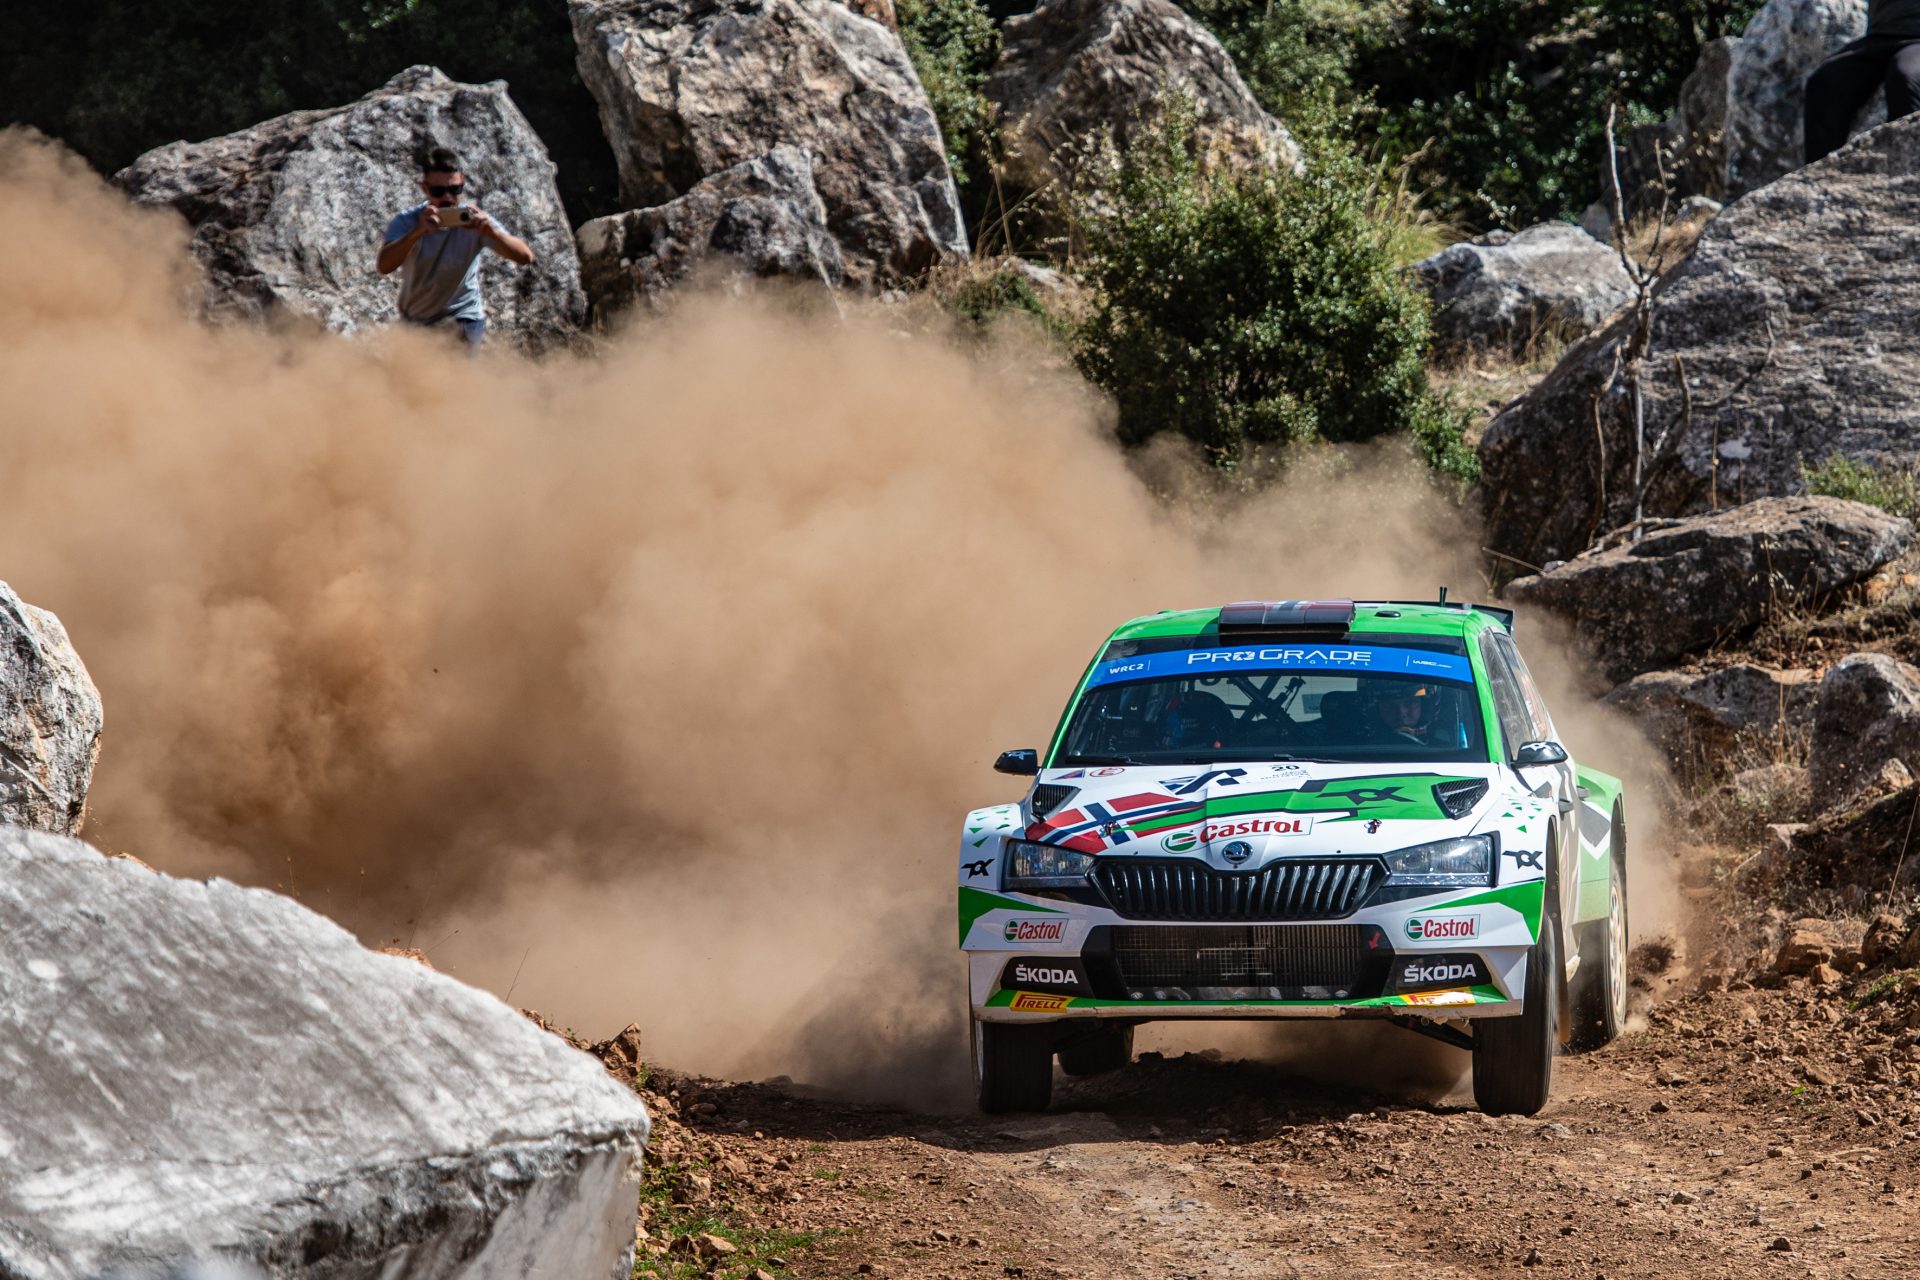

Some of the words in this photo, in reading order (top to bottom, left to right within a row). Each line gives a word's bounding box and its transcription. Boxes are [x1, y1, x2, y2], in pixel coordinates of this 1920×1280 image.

[1109, 663, 1144, 674] WRC2
[1200, 819, 1303, 843] Castrol
[1018, 921, 1063, 940] Castrol
[1423, 918, 1475, 938] Castrol
[1015, 964, 1079, 984] ŠKODA
[1404, 964, 1477, 983] ŠKODA
[1014, 994, 1069, 1009] PIRELLI
